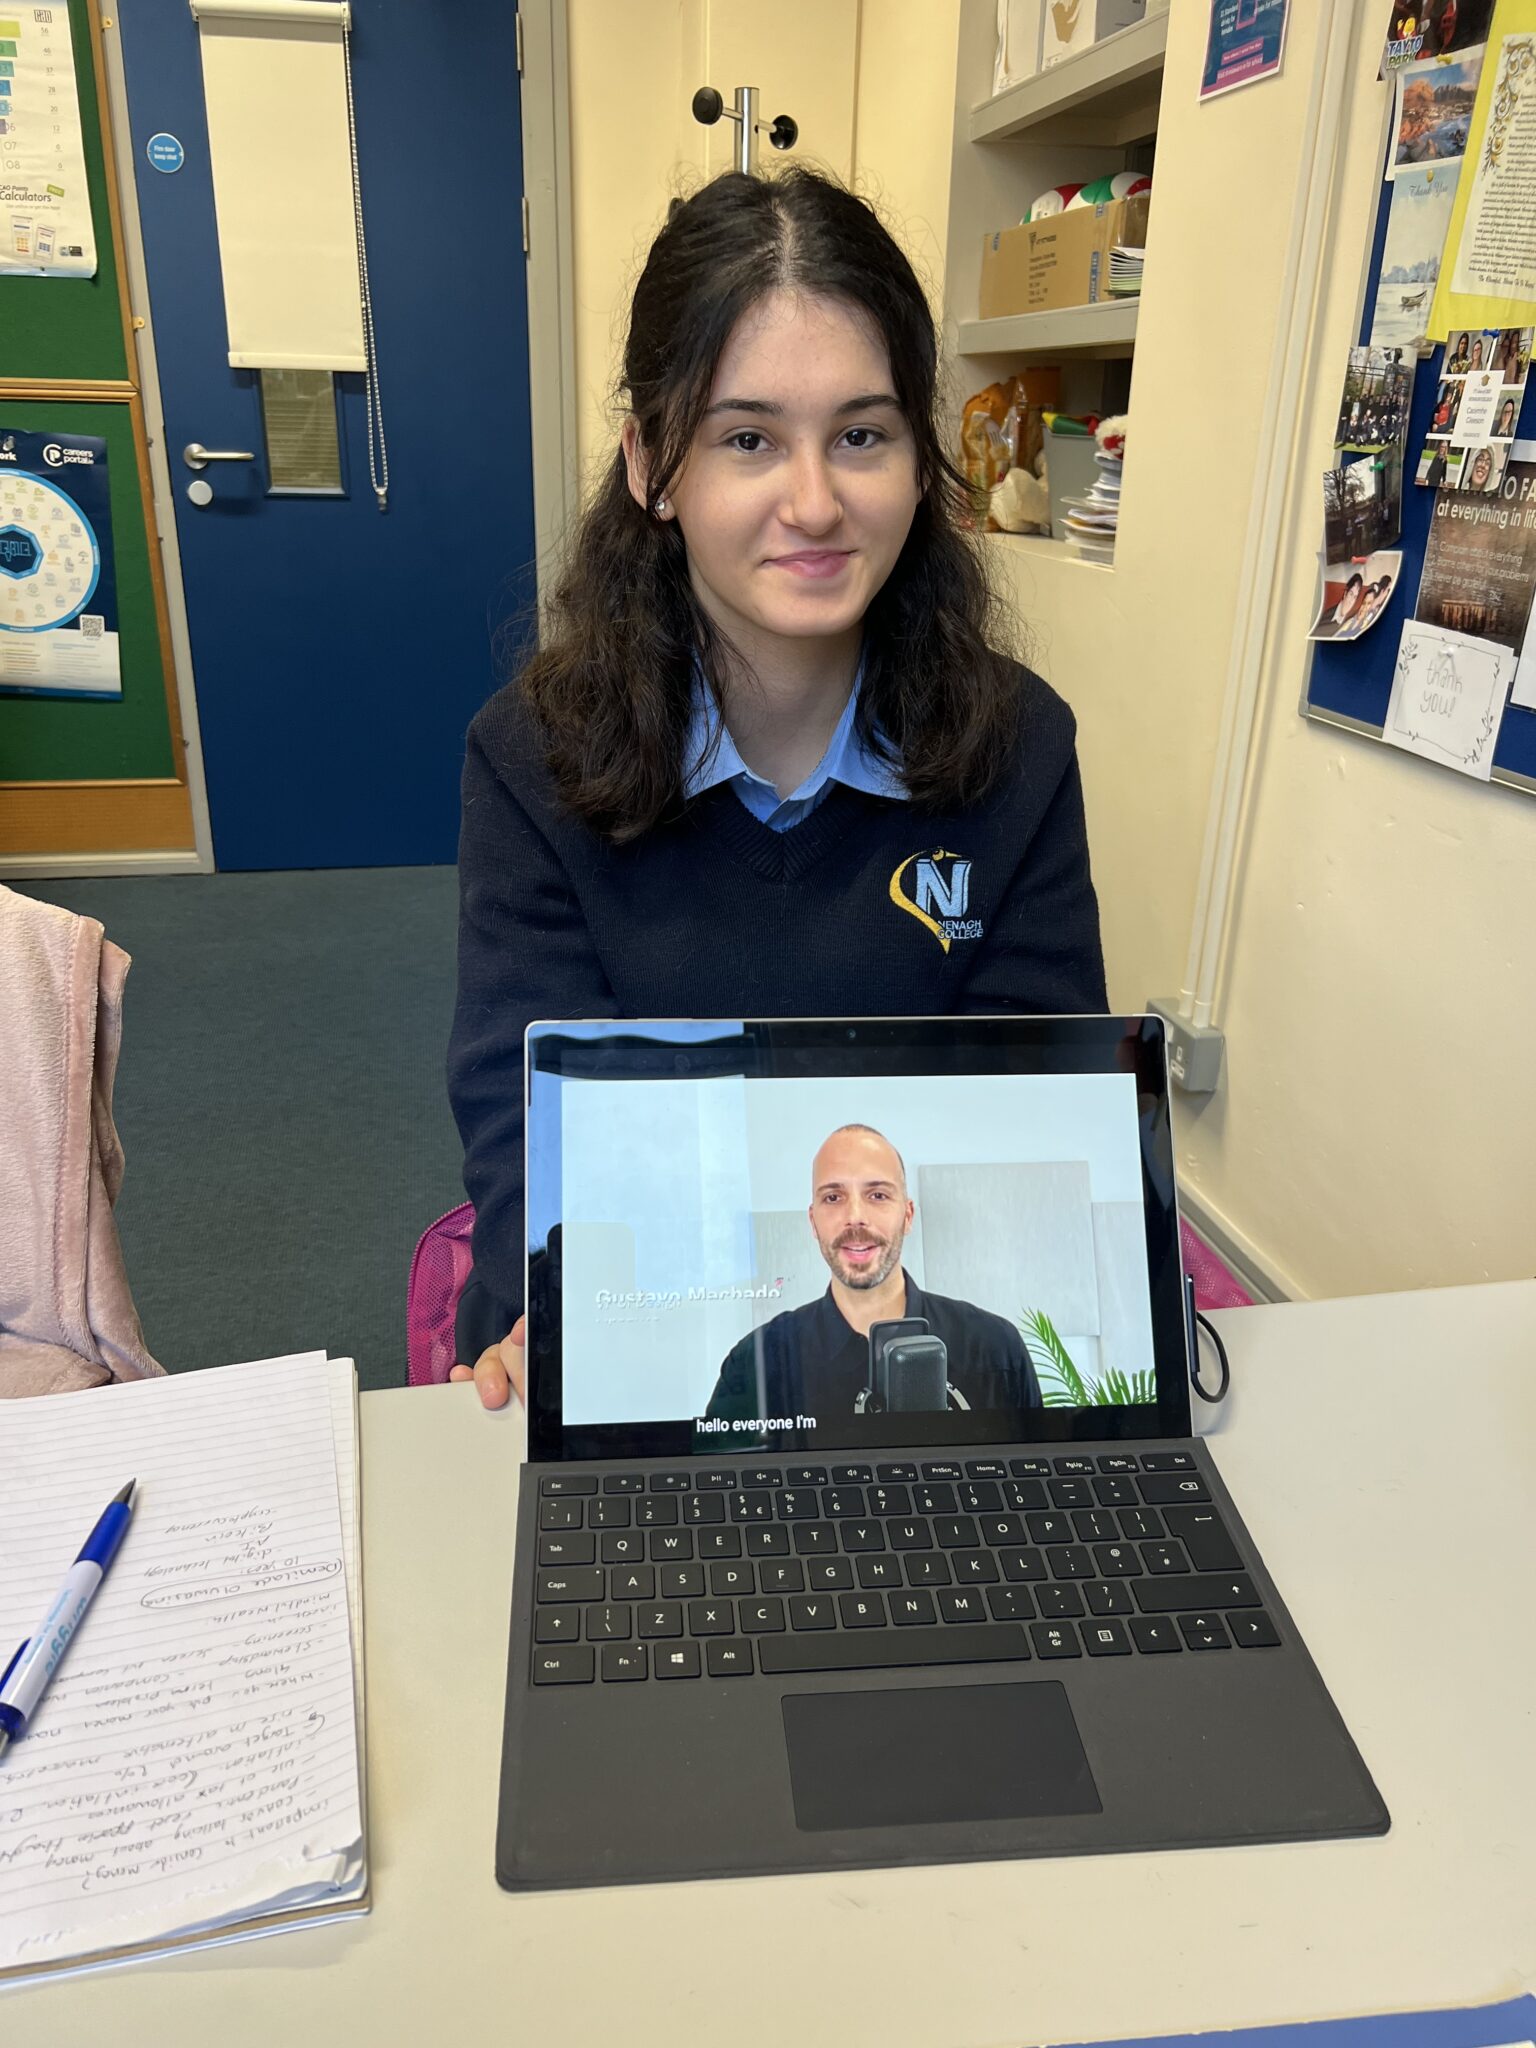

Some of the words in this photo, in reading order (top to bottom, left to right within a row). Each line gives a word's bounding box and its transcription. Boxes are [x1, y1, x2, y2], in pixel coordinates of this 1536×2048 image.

[1388, 35, 1424, 57] TAYTO
[1387, 54, 1415, 69] PARK
[0, 191, 52, 202] Calculators
[1437, 500, 1450, 517] at
[1451, 502, 1509, 530] everything
[1510, 507, 1522, 527] in
[1420, 689, 1456, 718] you!
[938, 920, 981, 930] NENAGH
[938, 929, 983, 940] COLLEGE
[696, 1418, 730, 1432] hello
[732, 1418, 794, 1434] everyone
[796, 1414, 817, 1429] I'm
[598, 1513, 604, 1521] 1
[645, 1510, 653, 1520] 2
[693, 1508, 701, 1518] 3
[740, 1506, 748, 1515] 4
[786, 1504, 794, 1513] 5
[833, 1502, 841, 1511] 6
[879, 1500, 886, 1509] 7
[925, 1498, 933, 1508] 8
[970, 1496, 978, 1506] 9
[1016, 1495, 1024, 1504] 0
[549, 1544, 563, 1552] Tab
[616, 1540, 628, 1552] Q
[664, 1537, 678, 1548] W
[715, 1535, 723, 1546] E
[763, 1533, 772, 1544] R
[810, 1531, 819, 1541] T
[857, 1529, 866, 1539] Y
[904, 1527, 914, 1537] U
[953, 1525, 959, 1535] I
[997, 1523, 1009, 1533] O
[1044, 1521, 1053, 1531] P
[143, 1559, 211, 1577] technology
[254, 1562, 337, 1586] Demilade
[547, 1581, 567, 1590] Caps
[627, 1576, 638, 1587] A
[678, 1573, 687, 1584] S
[727, 1571, 738, 1582] D
[778, 1569, 785, 1580] F
[825, 1566, 836, 1578] G
[873, 1564, 884, 1575] H
[924, 1563, 930, 1573] J
[970, 1560, 981, 1571] K
[1019, 1558, 1028, 1569] L
[655, 1613, 665, 1624] Z
[706, 1610, 716, 1621] X
[757, 1608, 767, 1619] C
[806, 1605, 817, 1616] V
[857, 1603, 867, 1614] B
[906, 1600, 918, 1611] N
[954, 1598, 969, 1609] M
[1048, 1630, 1061, 1641] Alt
[1051, 1638, 1062, 1647] Gr
[543, 1660, 560, 1669] Ctrl
[618, 1657, 630, 1665] Fn
[722, 1651, 736, 1660] Alt
[245, 1725, 295, 1748] Target
